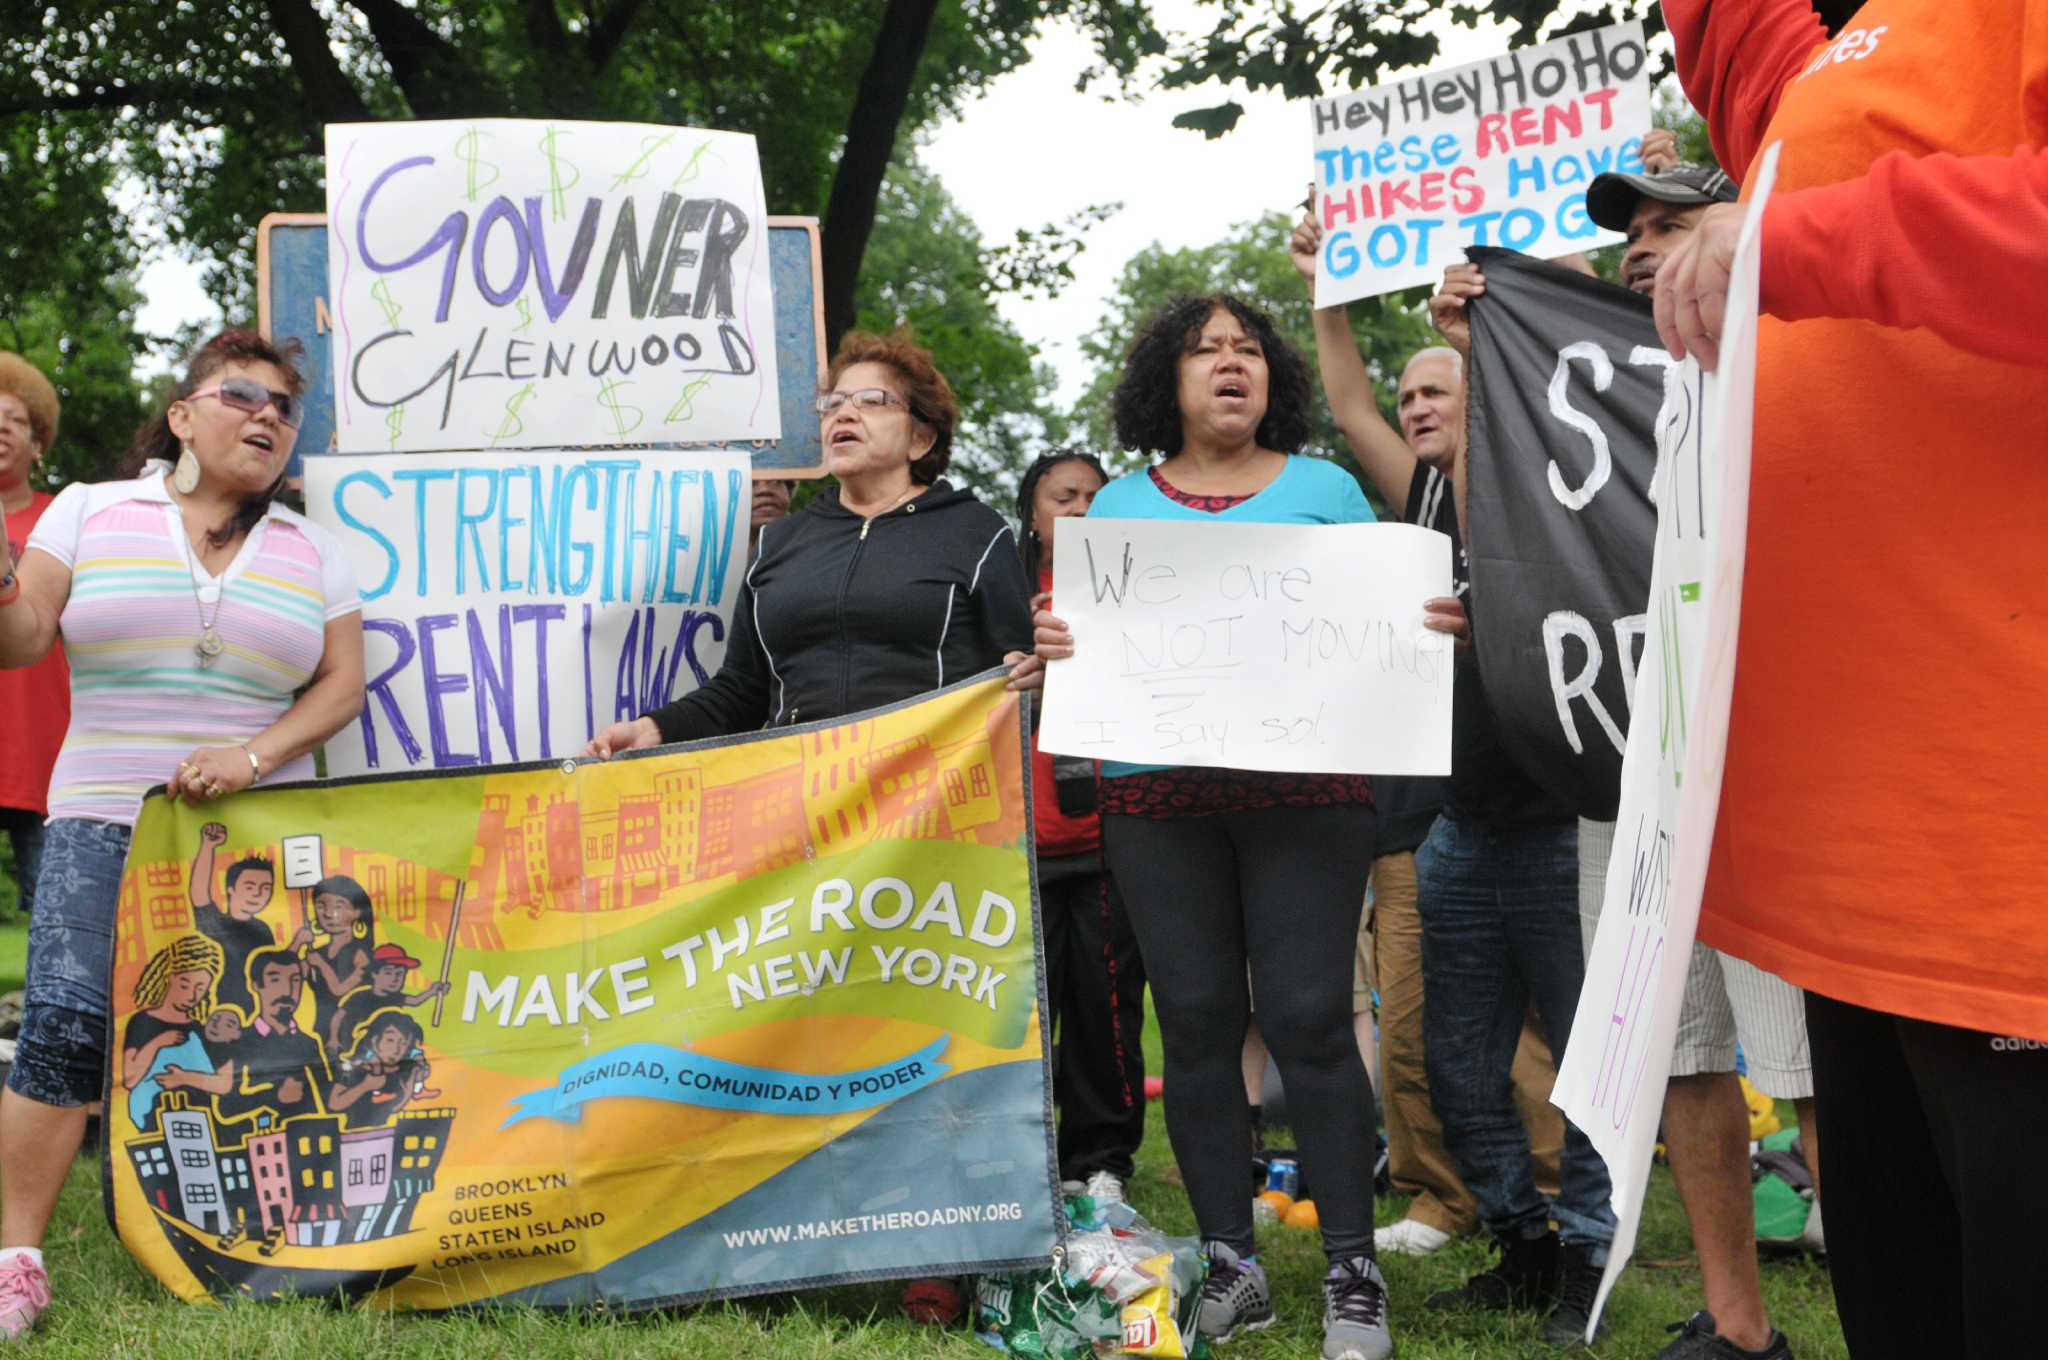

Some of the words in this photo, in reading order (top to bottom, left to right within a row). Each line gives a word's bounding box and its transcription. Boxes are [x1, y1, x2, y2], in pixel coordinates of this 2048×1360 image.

[1315, 96, 1390, 136] Hey
[1398, 70, 1482, 119] Hey
[1315, 133, 1462, 187] These
[1476, 88, 1619, 159] RENT
[1323, 166, 1485, 230] HIKES
[357, 155, 749, 323] GOVNER
[1325, 219, 1444, 279] GOT
[1458, 208, 1545, 251] TO
[352, 318, 756, 431] GLENWOOD
[333, 459, 742, 607] STRENGTHEN
[1085, 537, 1181, 608] We
[1219, 563, 1312, 602] are
[1121, 614, 1244, 670] NOT
[361, 604, 566, 768] RENT
[1073, 720, 1120, 744] I
[1153, 719, 1228, 757] say
[462, 956, 656, 1028] MAKE
[661, 896, 795, 989] THE
[810, 877, 1017, 948] ROAD
[726, 946, 854, 1010] NEW
[871, 945, 1008, 1011] YORK
[563, 1060, 669, 1095] DIGNIDAD,
[678, 1069, 821, 1102] COMUNIDAD
[828, 1084, 842, 1101] Y
[849, 1061, 925, 1098] PODER
[449, 1201, 532, 1225] QUEENS
[455, 1173, 567, 1200] BROOKLYN
[432, 1251, 496, 1270] LONG
[500, 1239, 576, 1259] ISLAND
[439, 1226, 520, 1250] STATEN
[528, 1211, 605, 1238] ISLAND
[722, 1203, 1022, 1248] WWW.MAKETHEROADNY.ORG
